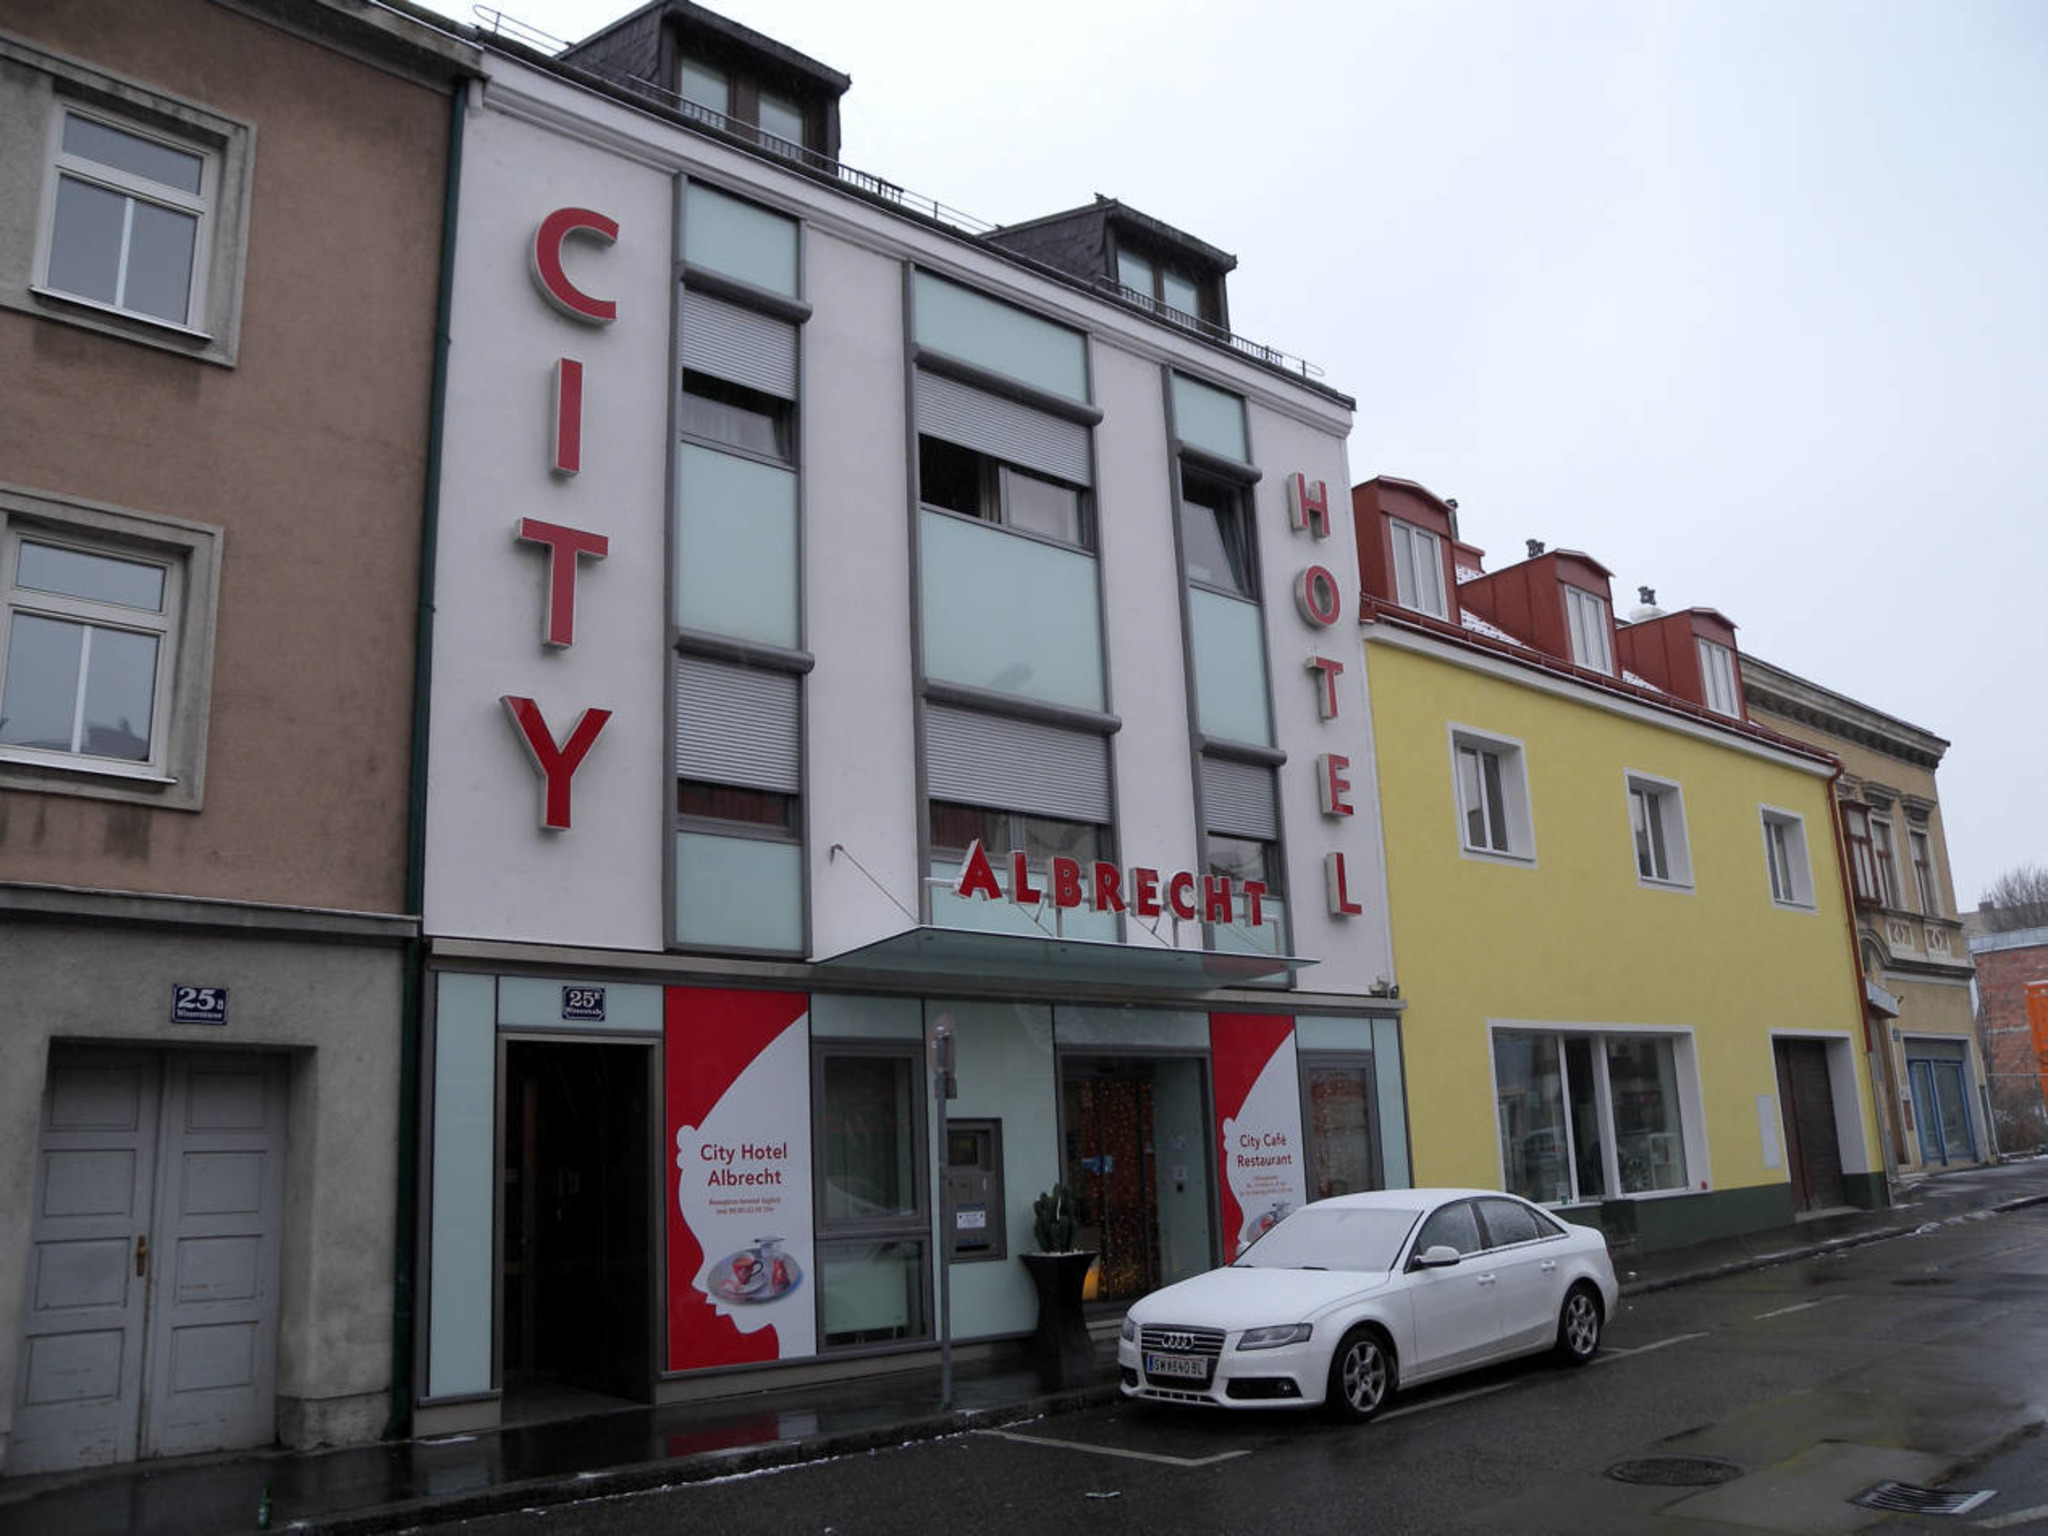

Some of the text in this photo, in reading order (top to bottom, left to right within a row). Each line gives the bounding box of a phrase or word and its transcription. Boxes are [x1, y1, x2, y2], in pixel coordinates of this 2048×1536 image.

[501, 207, 619, 831] CITY
[1291, 472, 1363, 917] HOTEL
[957, 838, 1268, 927] ALBRECHT
[700, 1141, 788, 1166] City Hotel
[1239, 1133, 1261, 1151] City
[1237, 1153, 1293, 1169] Restaurant
[707, 1167, 782, 1188] Albrecht
